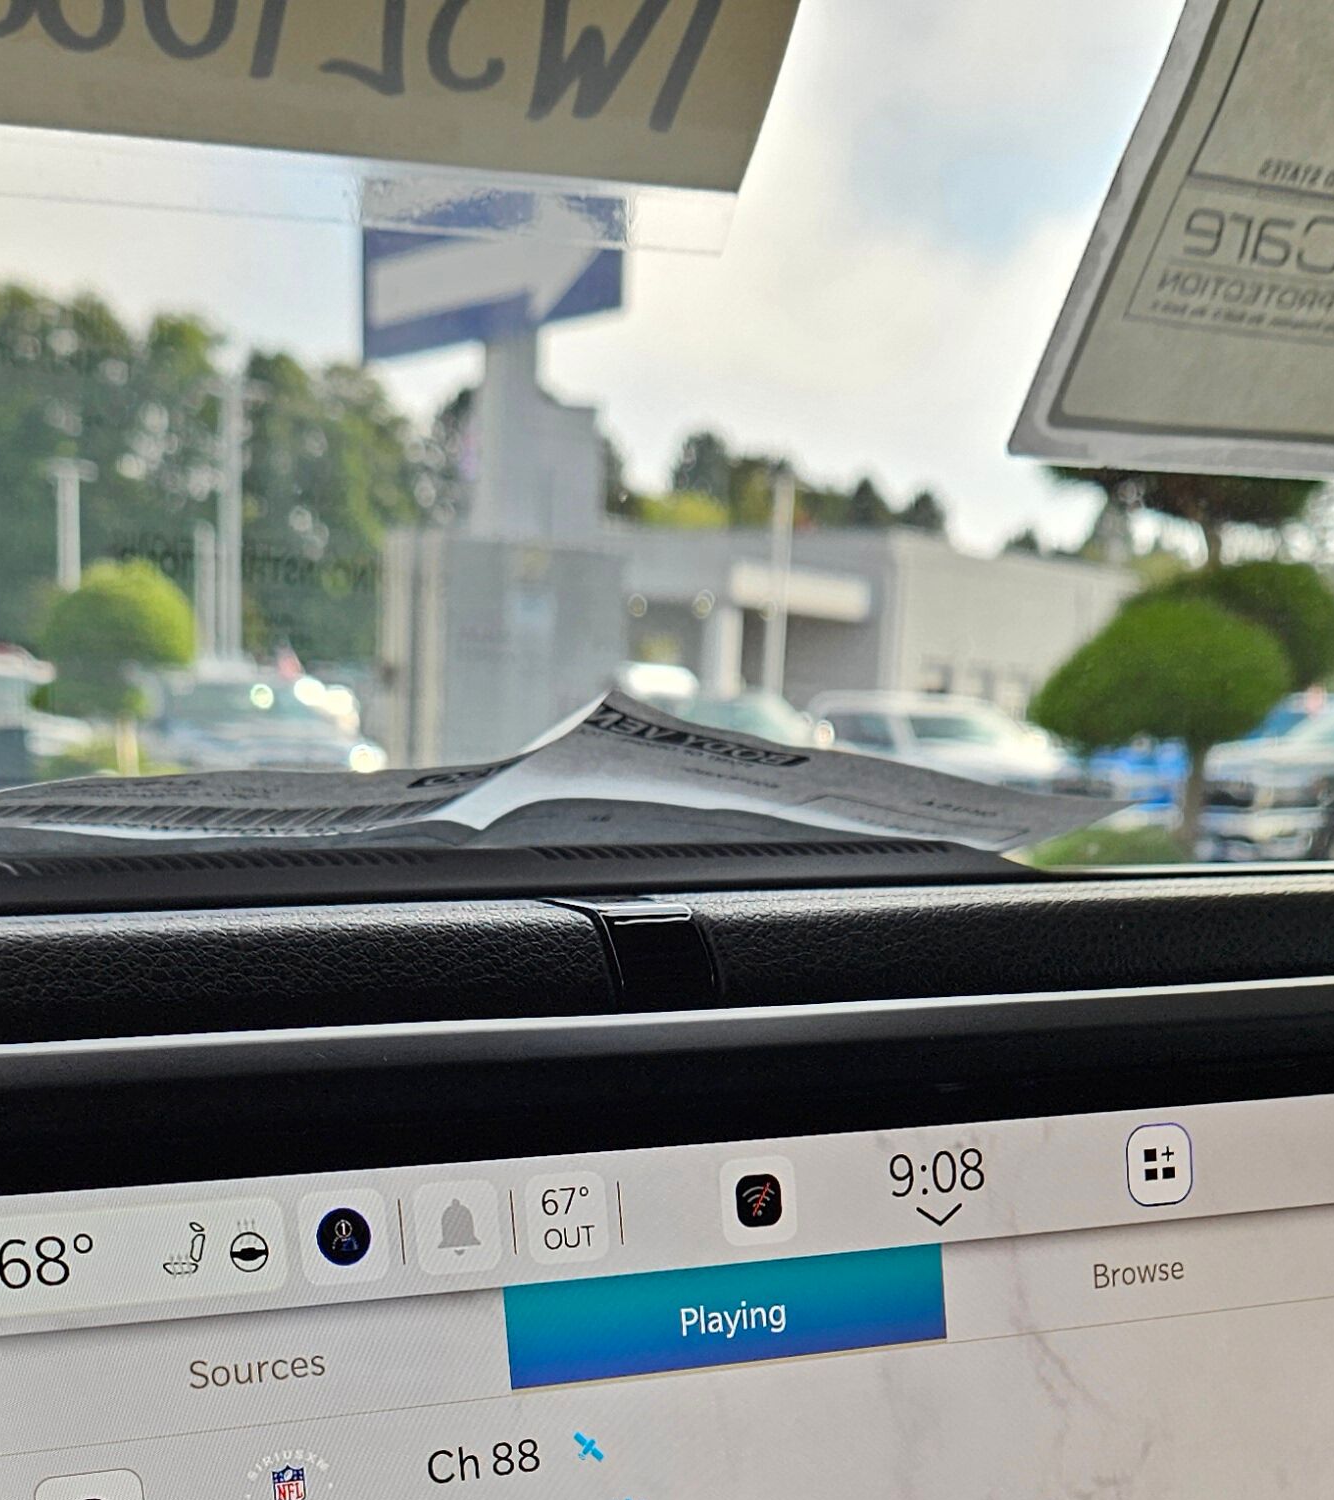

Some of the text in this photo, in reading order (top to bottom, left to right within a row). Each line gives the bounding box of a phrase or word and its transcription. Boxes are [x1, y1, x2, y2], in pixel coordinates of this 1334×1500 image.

[889, 1147, 986, 1198] 9:08
[540, 1185, 591, 1218] 67°
[543, 1224, 596, 1252] OUT
[1092, 1255, 1185, 1291] Browse
[679, 1297, 788, 1341] Playing
[188, 1350, 327, 1392] Sources
[426, 1439, 542, 1487] Ch 88
